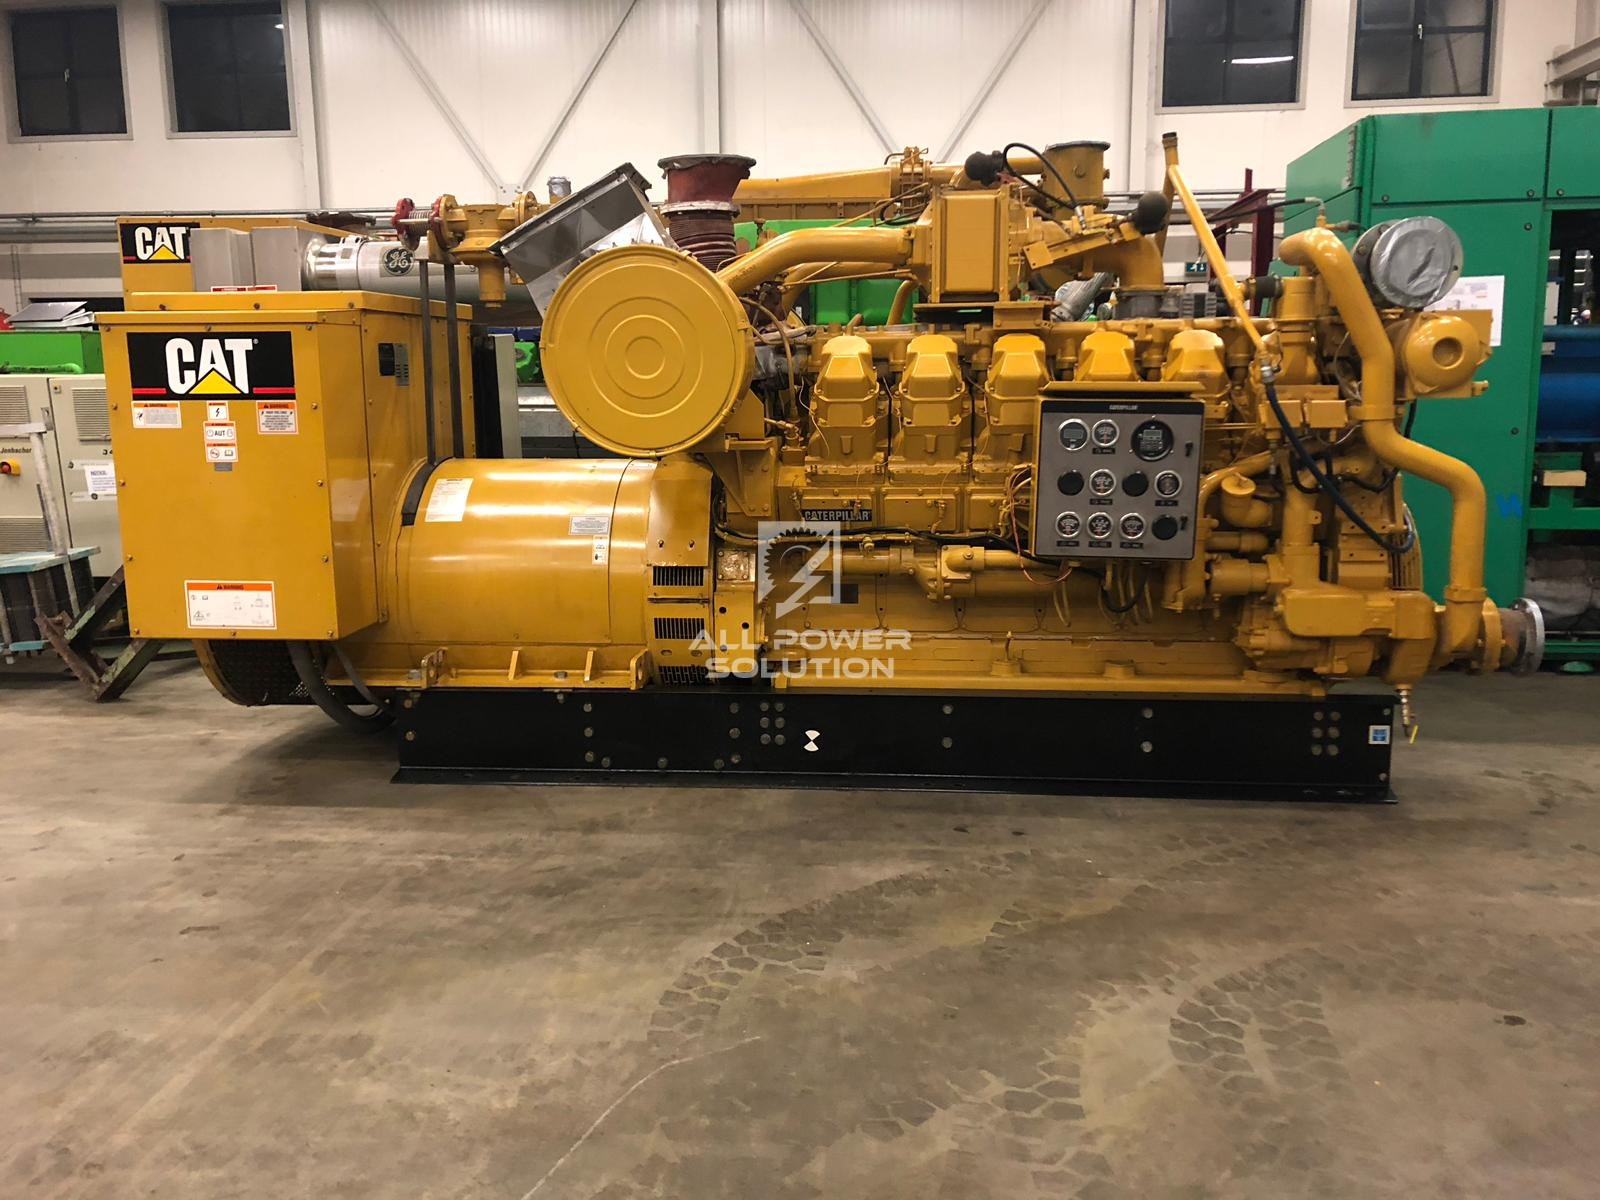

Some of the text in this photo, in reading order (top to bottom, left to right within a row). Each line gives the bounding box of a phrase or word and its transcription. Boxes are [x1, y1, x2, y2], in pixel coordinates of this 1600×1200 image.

[134, 226, 187, 261] CAT
[165, 337, 254, 395] CAT
[804, 510, 870, 520] CATERPILLAR
